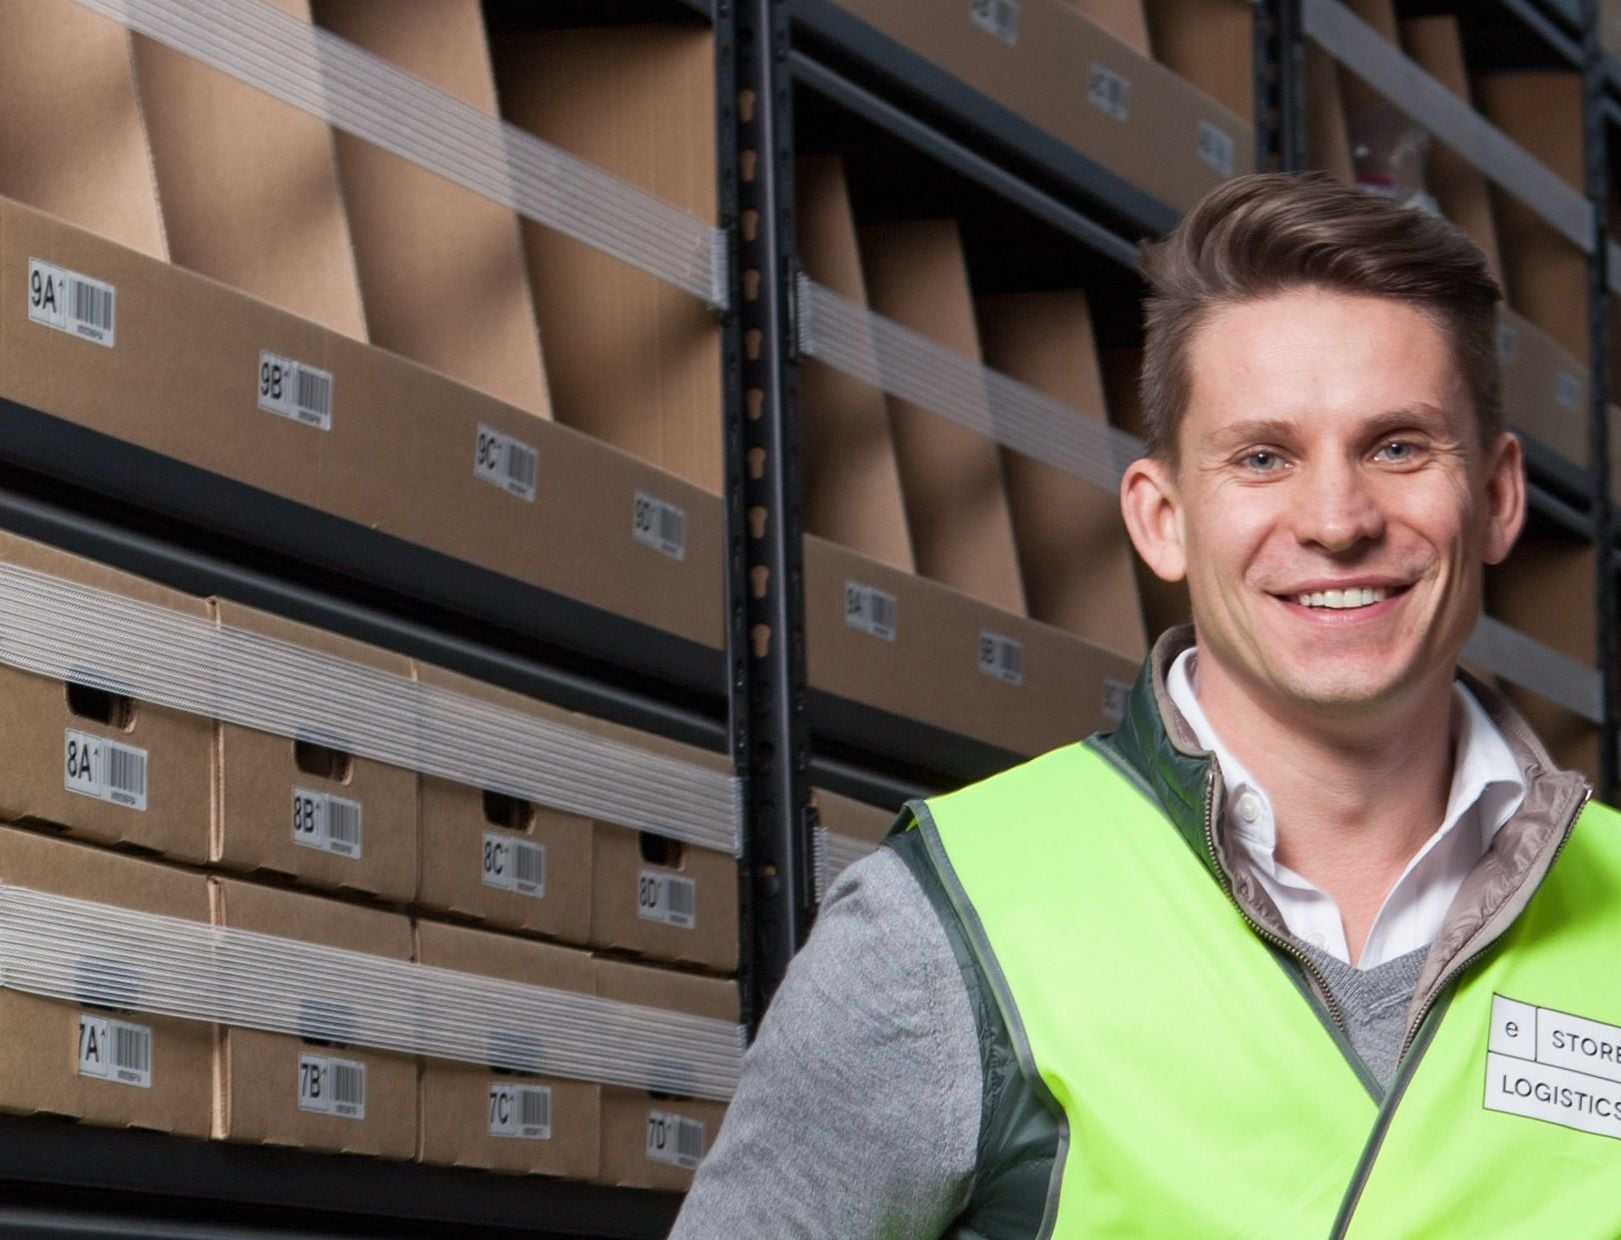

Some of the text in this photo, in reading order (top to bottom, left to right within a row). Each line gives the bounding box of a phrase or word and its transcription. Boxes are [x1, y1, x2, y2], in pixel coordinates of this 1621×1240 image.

[31, 270, 57, 313] 9A
[260, 362, 283, 400] 9B
[477, 433, 496, 470] 9C
[67, 740, 92, 783] 8A
[293, 796, 315, 833] 8B
[484, 840, 504, 875] 8C
[1505, 1021, 1519, 1038] e
[301, 1063, 321, 1098] 7B
[490, 1092, 509, 1124] 7C
[649, 1118, 666, 1149] 7D
